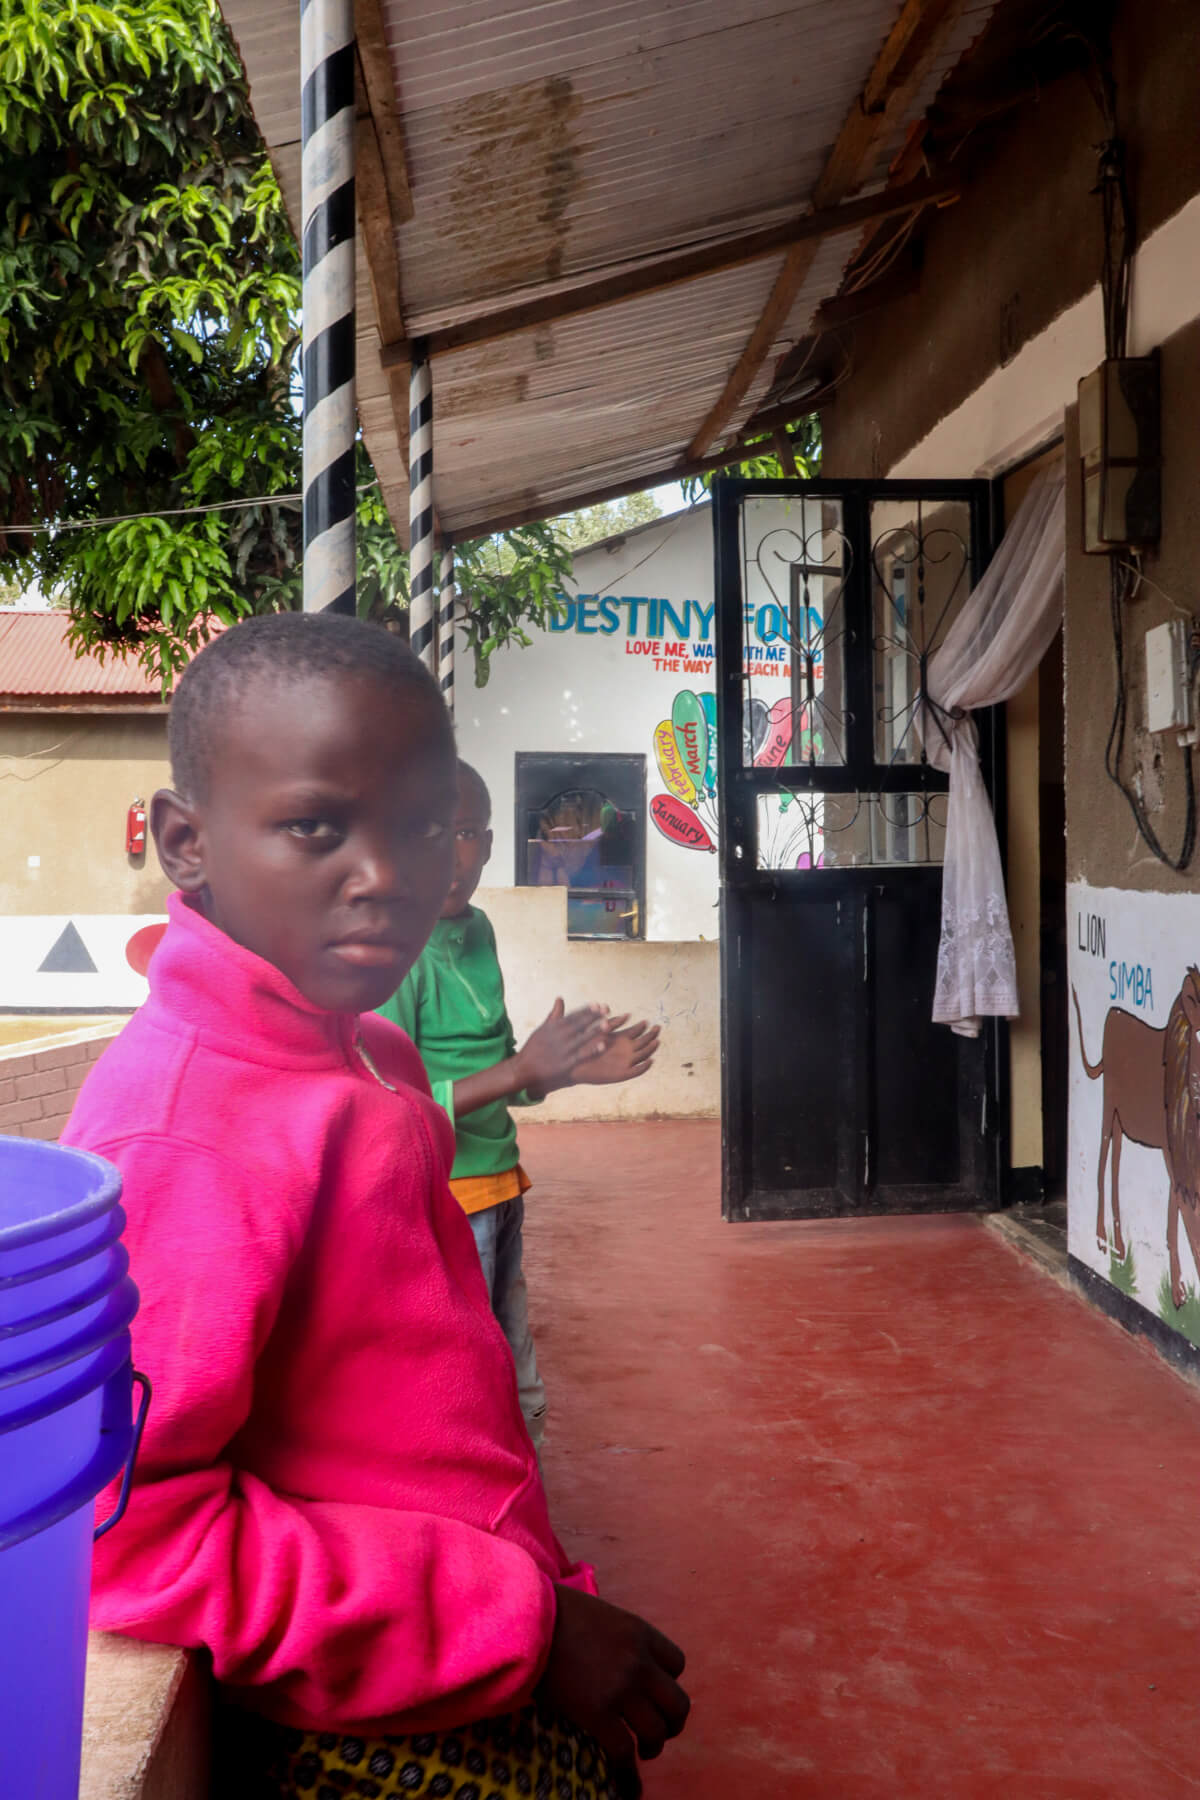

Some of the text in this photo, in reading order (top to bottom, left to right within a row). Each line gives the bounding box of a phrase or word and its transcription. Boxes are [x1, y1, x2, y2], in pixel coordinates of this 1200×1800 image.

[549, 594, 824, 646] DESTINY FOUN
[625, 640, 660, 655] LOVE
[664, 642, 689, 659] ME,
[693, 643, 717, 658] WA
[743, 646, 763, 660] ITH
[765, 647, 786, 661] ME
[652, 658, 679, 672] THE
[683, 660, 713, 674] WAY
[743, 662, 779, 677] EACH
[659, 730, 691, 796] February
[676, 722, 701, 775] March
[653, 801, 704, 843] January
[1078, 911, 1106, 959] LION
[1109, 960, 1154, 1011] SIMBA
